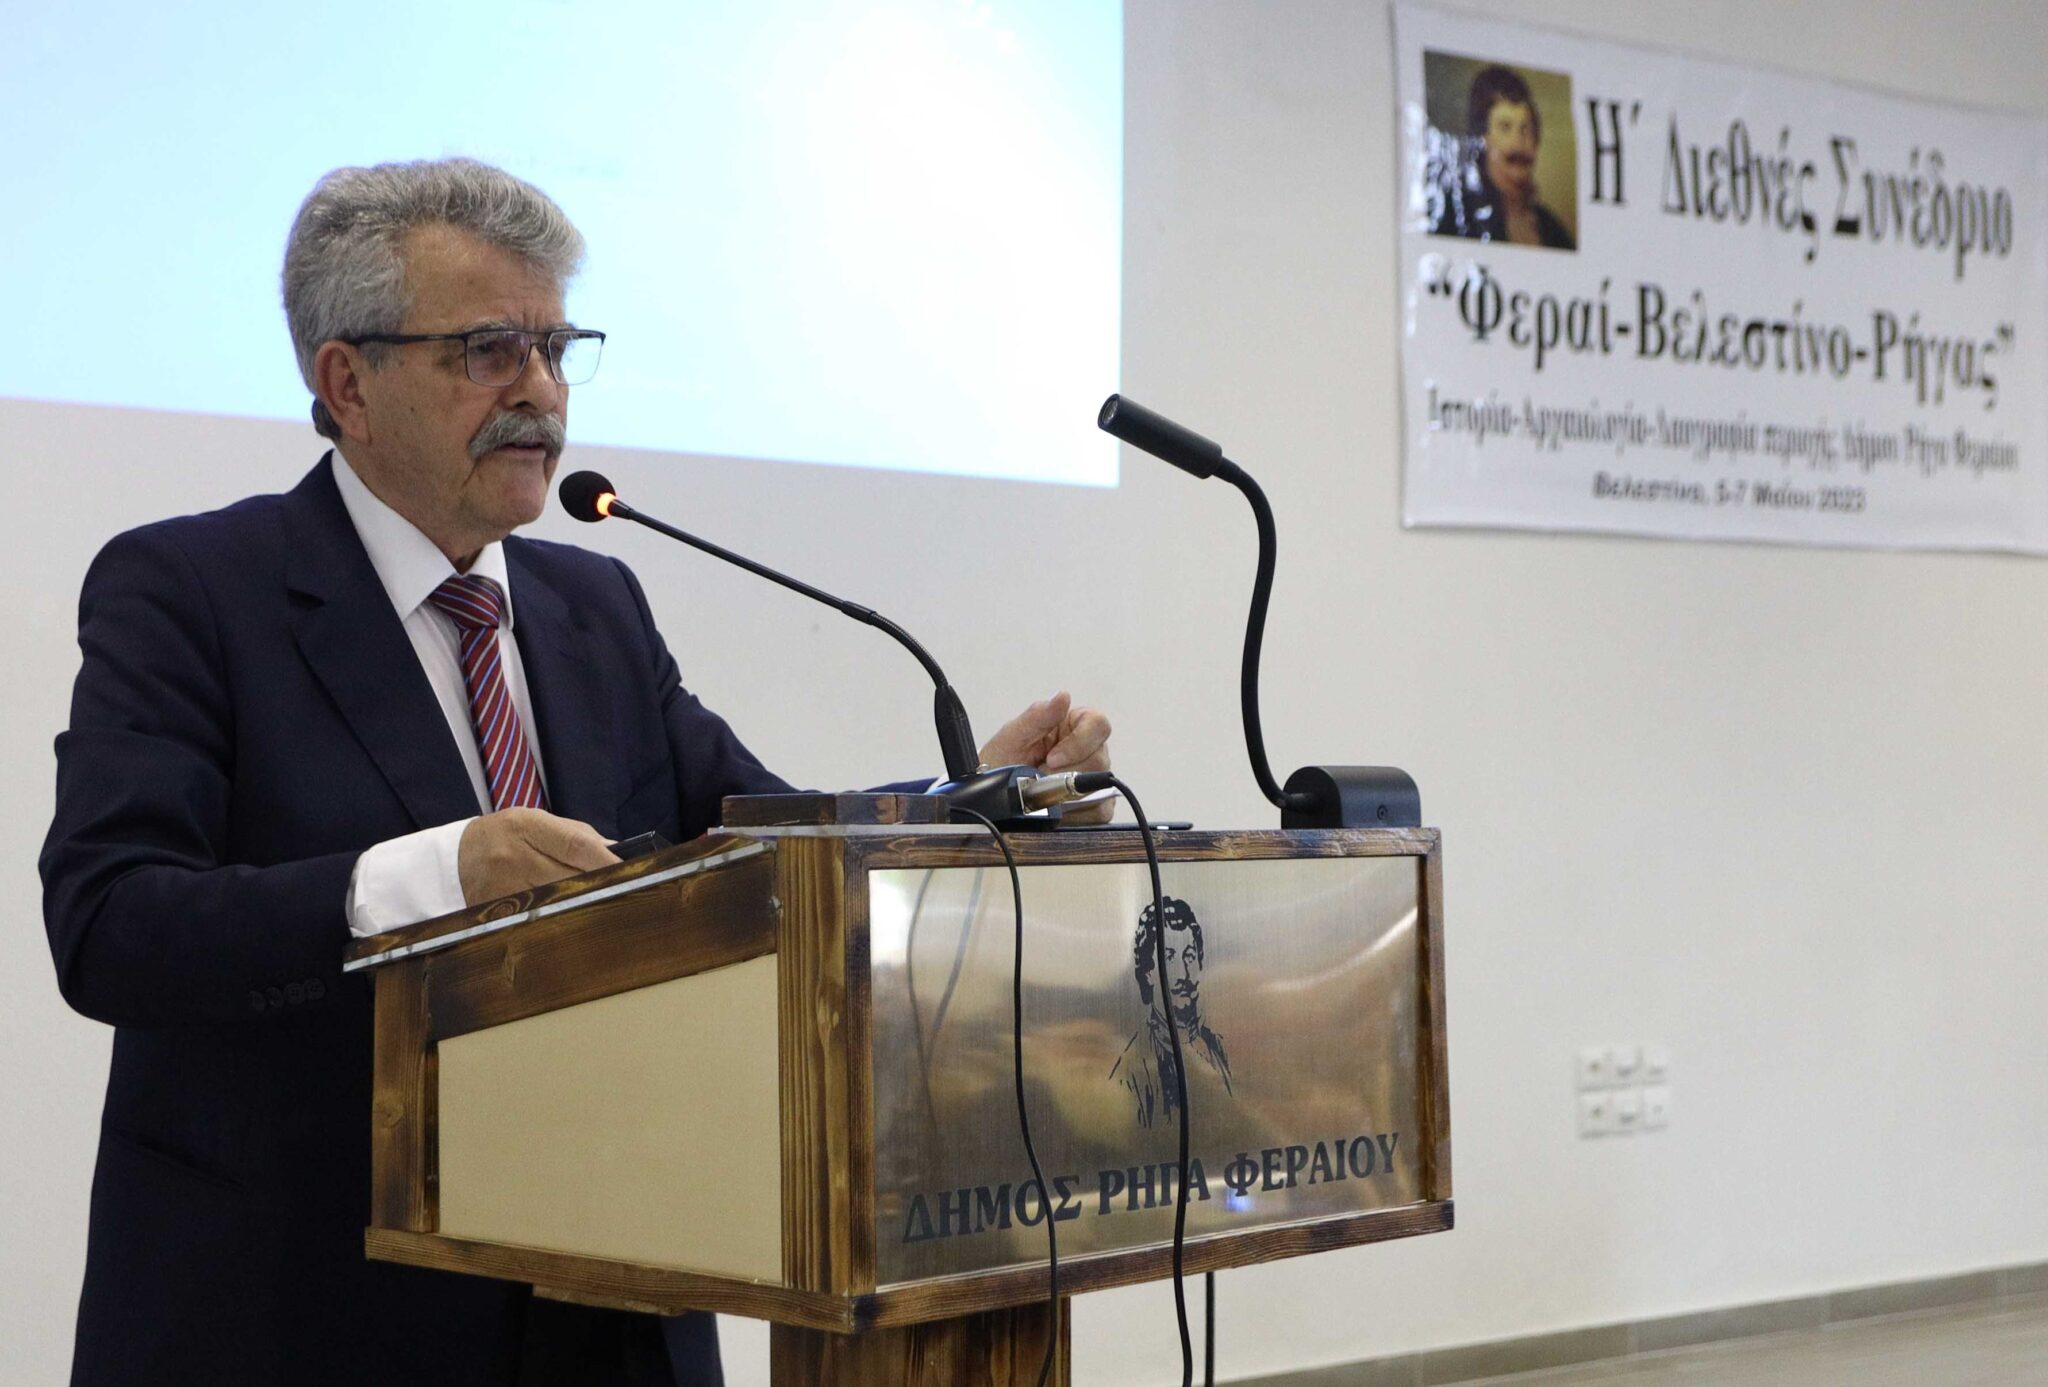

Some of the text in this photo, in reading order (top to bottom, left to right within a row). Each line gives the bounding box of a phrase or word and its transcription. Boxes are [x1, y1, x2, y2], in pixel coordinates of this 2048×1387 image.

[1663, 111, 1820, 263] Διεθνές
[1830, 135, 2013, 281] Συνέδριο
[902, 1132, 1398, 1244] ΔΗΜΟΣ ΡΗΓΑ ΦΕΡΑΙΟΥ
